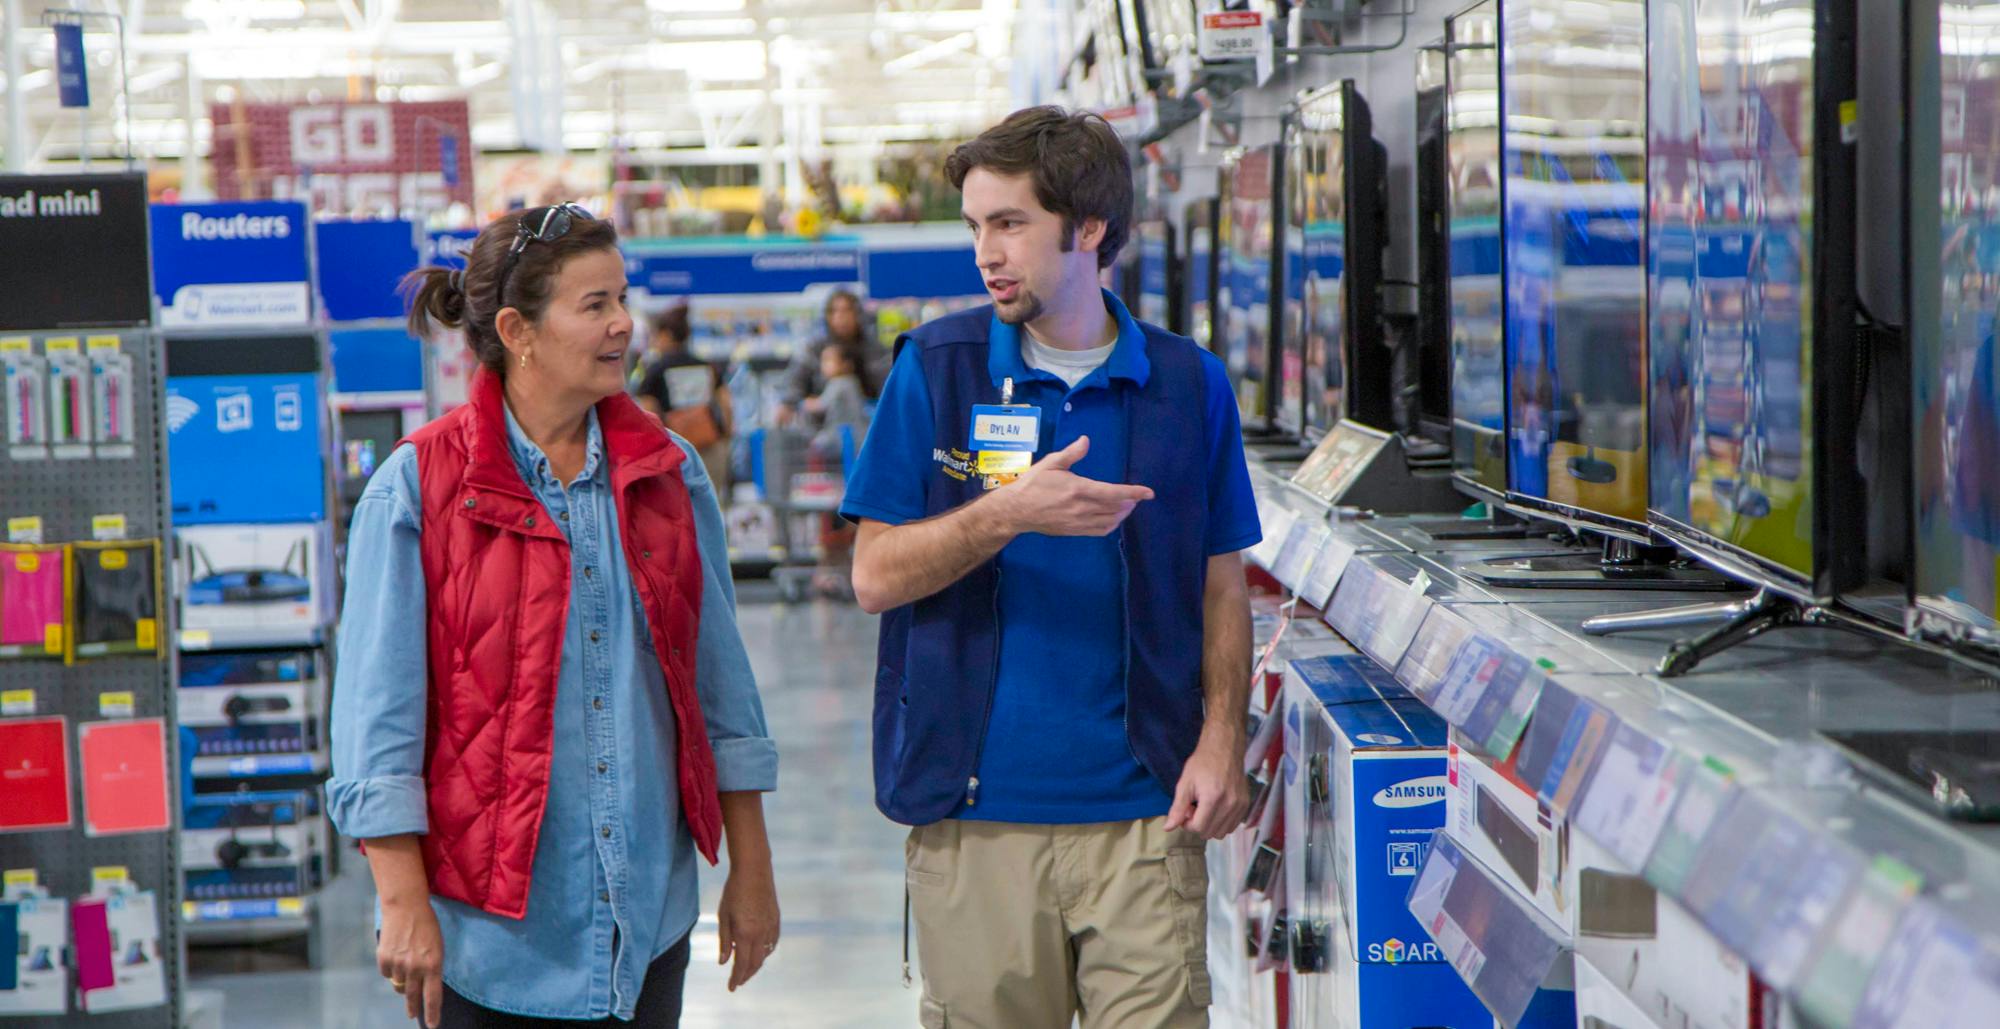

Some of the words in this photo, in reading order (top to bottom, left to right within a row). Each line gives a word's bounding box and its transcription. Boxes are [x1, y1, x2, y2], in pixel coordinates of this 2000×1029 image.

[290, 105, 394, 164] GO
[0, 189, 36, 218] ad
[39, 187, 101, 217] mini
[181, 211, 291, 240] Routers
[989, 423, 1021, 436] DYLAN
[933, 447, 969, 472] Walmart
[1385, 785, 1446, 798] SAMSUN
[1399, 852, 1409, 867] 6
